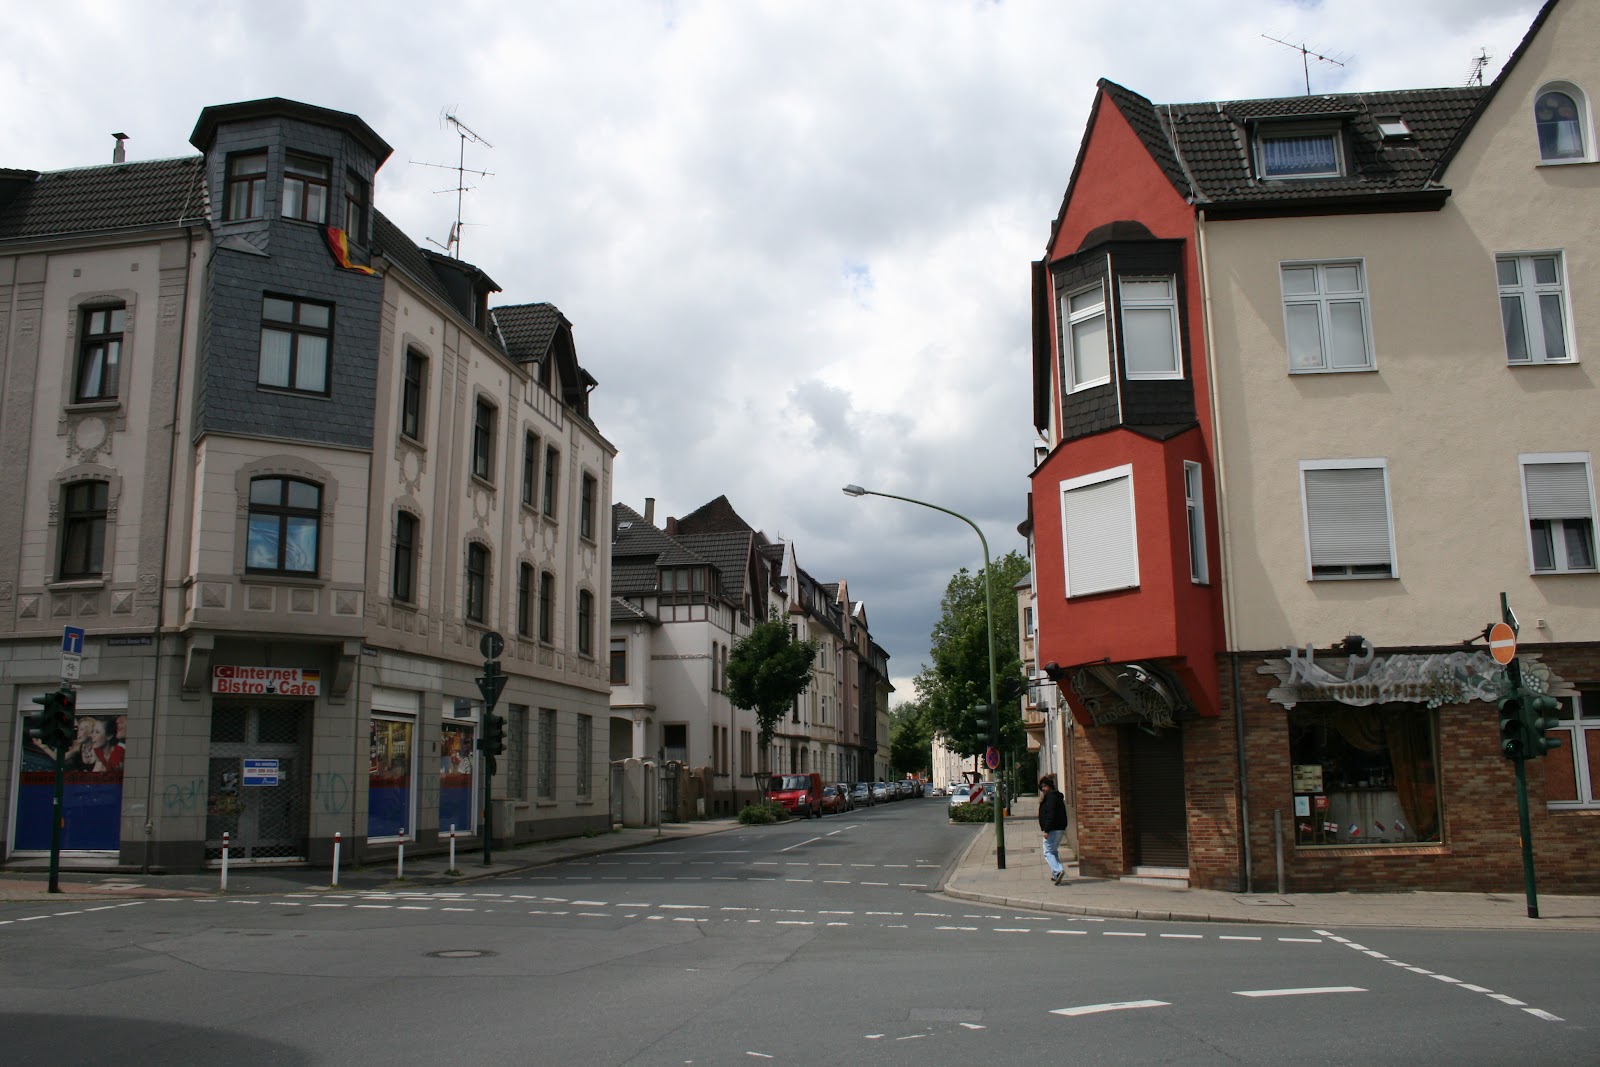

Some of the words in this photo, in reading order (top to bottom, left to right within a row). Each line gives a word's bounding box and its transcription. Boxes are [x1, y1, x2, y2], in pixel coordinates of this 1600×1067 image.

[235, 666, 298, 681] Internet
[217, 678, 264, 694] Bistro
[279, 681, 316, 695] Cafe
[1296, 683, 1380, 700] TRATTORIA
[1392, 682, 1463, 699] PIZZERIA
